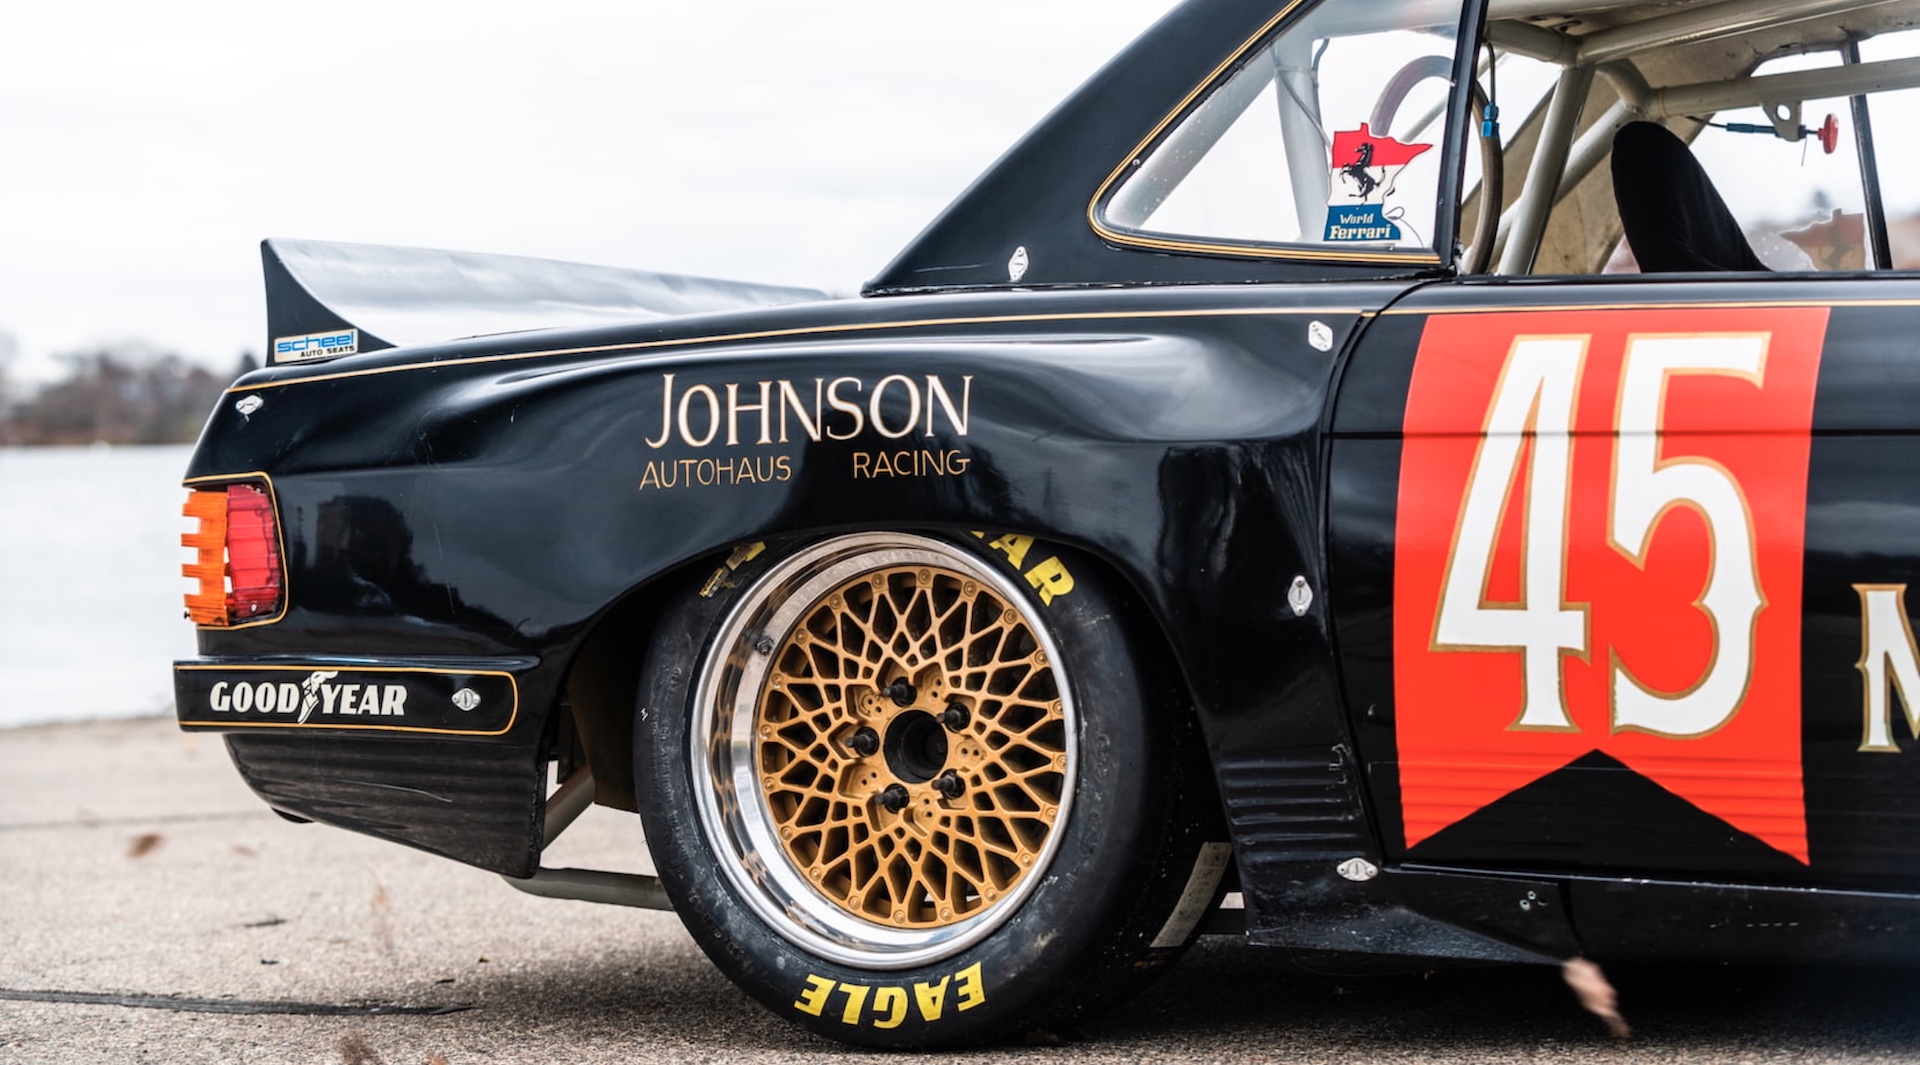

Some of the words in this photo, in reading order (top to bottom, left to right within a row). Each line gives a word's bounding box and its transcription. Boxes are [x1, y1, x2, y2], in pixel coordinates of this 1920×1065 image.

[1329, 224, 1391, 240] Ferrari
[1339, 213, 1374, 225] World
[277, 331, 354, 353] scheel
[300, 349, 323, 358] AUTO
[326, 345, 355, 354] SEATS
[644, 373, 974, 449] JOHNSON
[638, 455, 793, 491] AUTOHAUS
[852, 449, 972, 480] RACING
[1427, 331, 1772, 741] 45
[970, 530, 1075, 607] AR
[793, 961, 986, 1030] EAGLE
